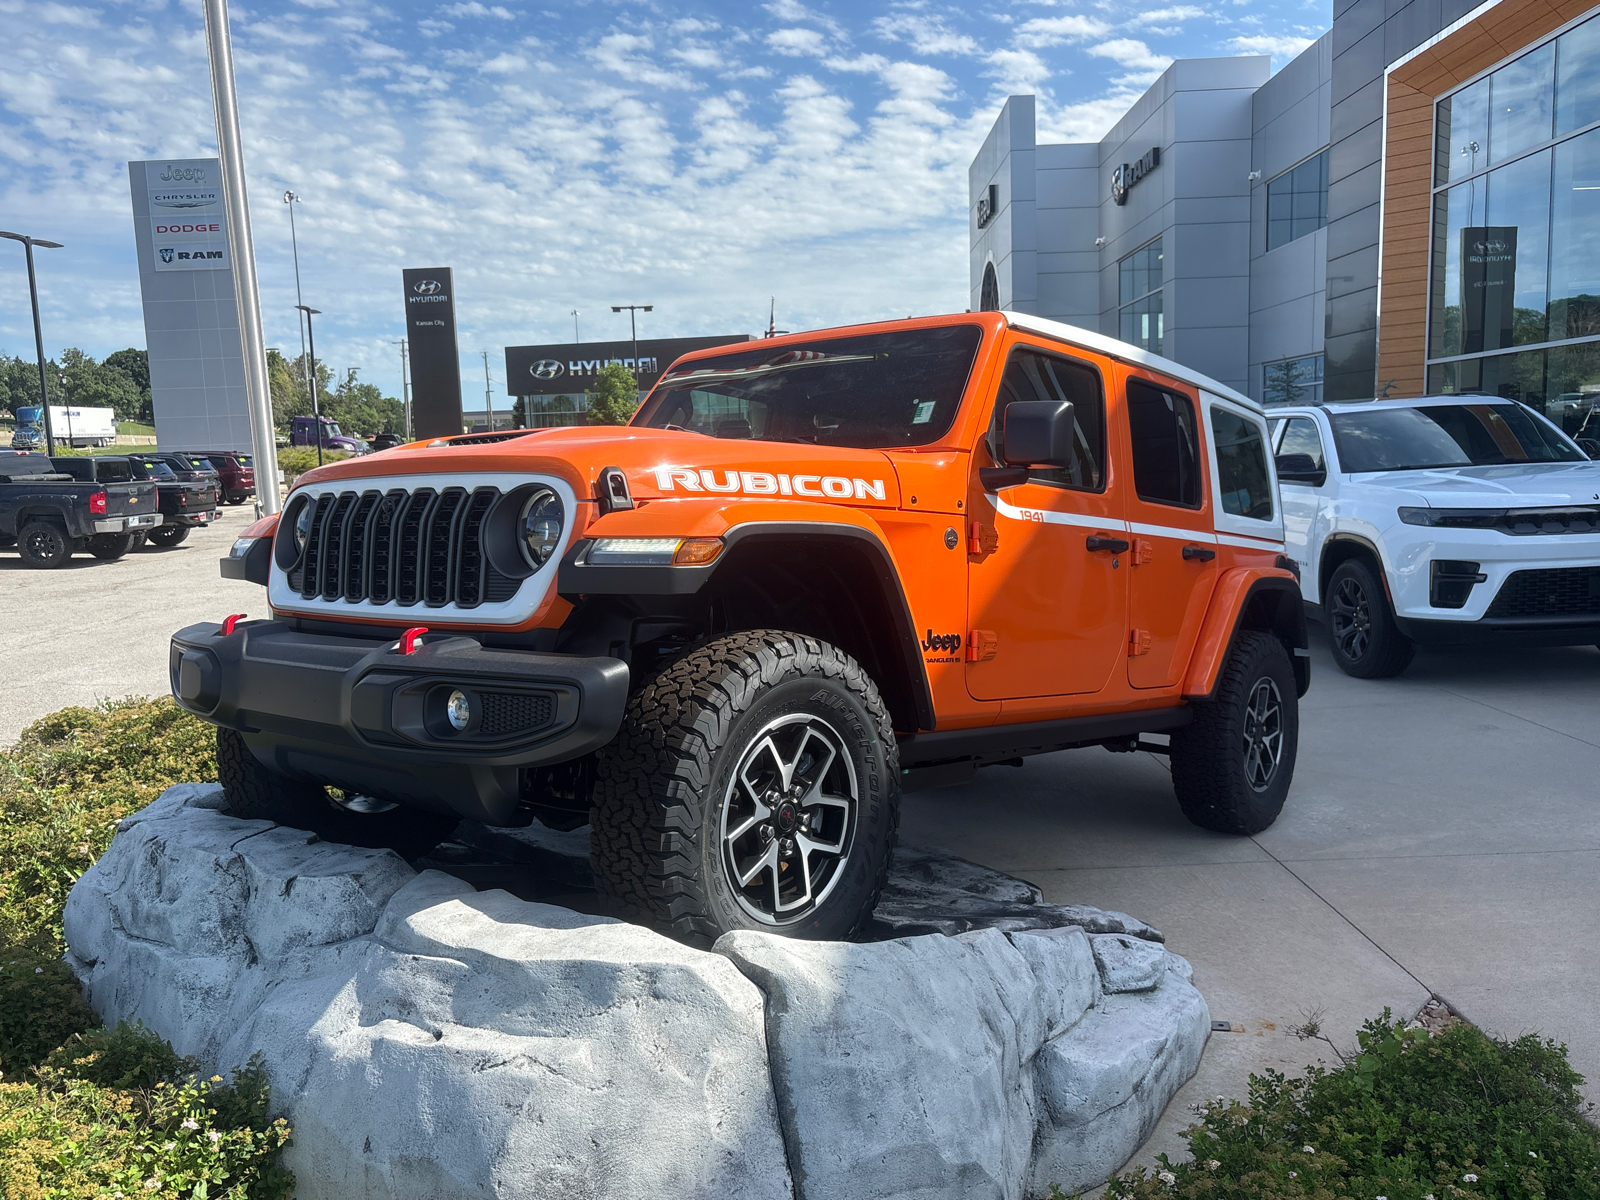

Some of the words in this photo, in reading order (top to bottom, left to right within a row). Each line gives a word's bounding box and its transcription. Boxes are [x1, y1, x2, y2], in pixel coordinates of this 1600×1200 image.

[160, 164, 206, 183] Jeep
[1124, 146, 1159, 190] RAM
[154, 193, 216, 201] CHRYSLER
[156, 223, 221, 234] DODGE
[177, 250, 223, 261] RAM
[409, 295, 448, 303] HYUNDAI
[655, 468, 886, 500] RUBICON
[1019, 509, 1044, 523] 1941
[921, 628, 961, 655] Jeep
